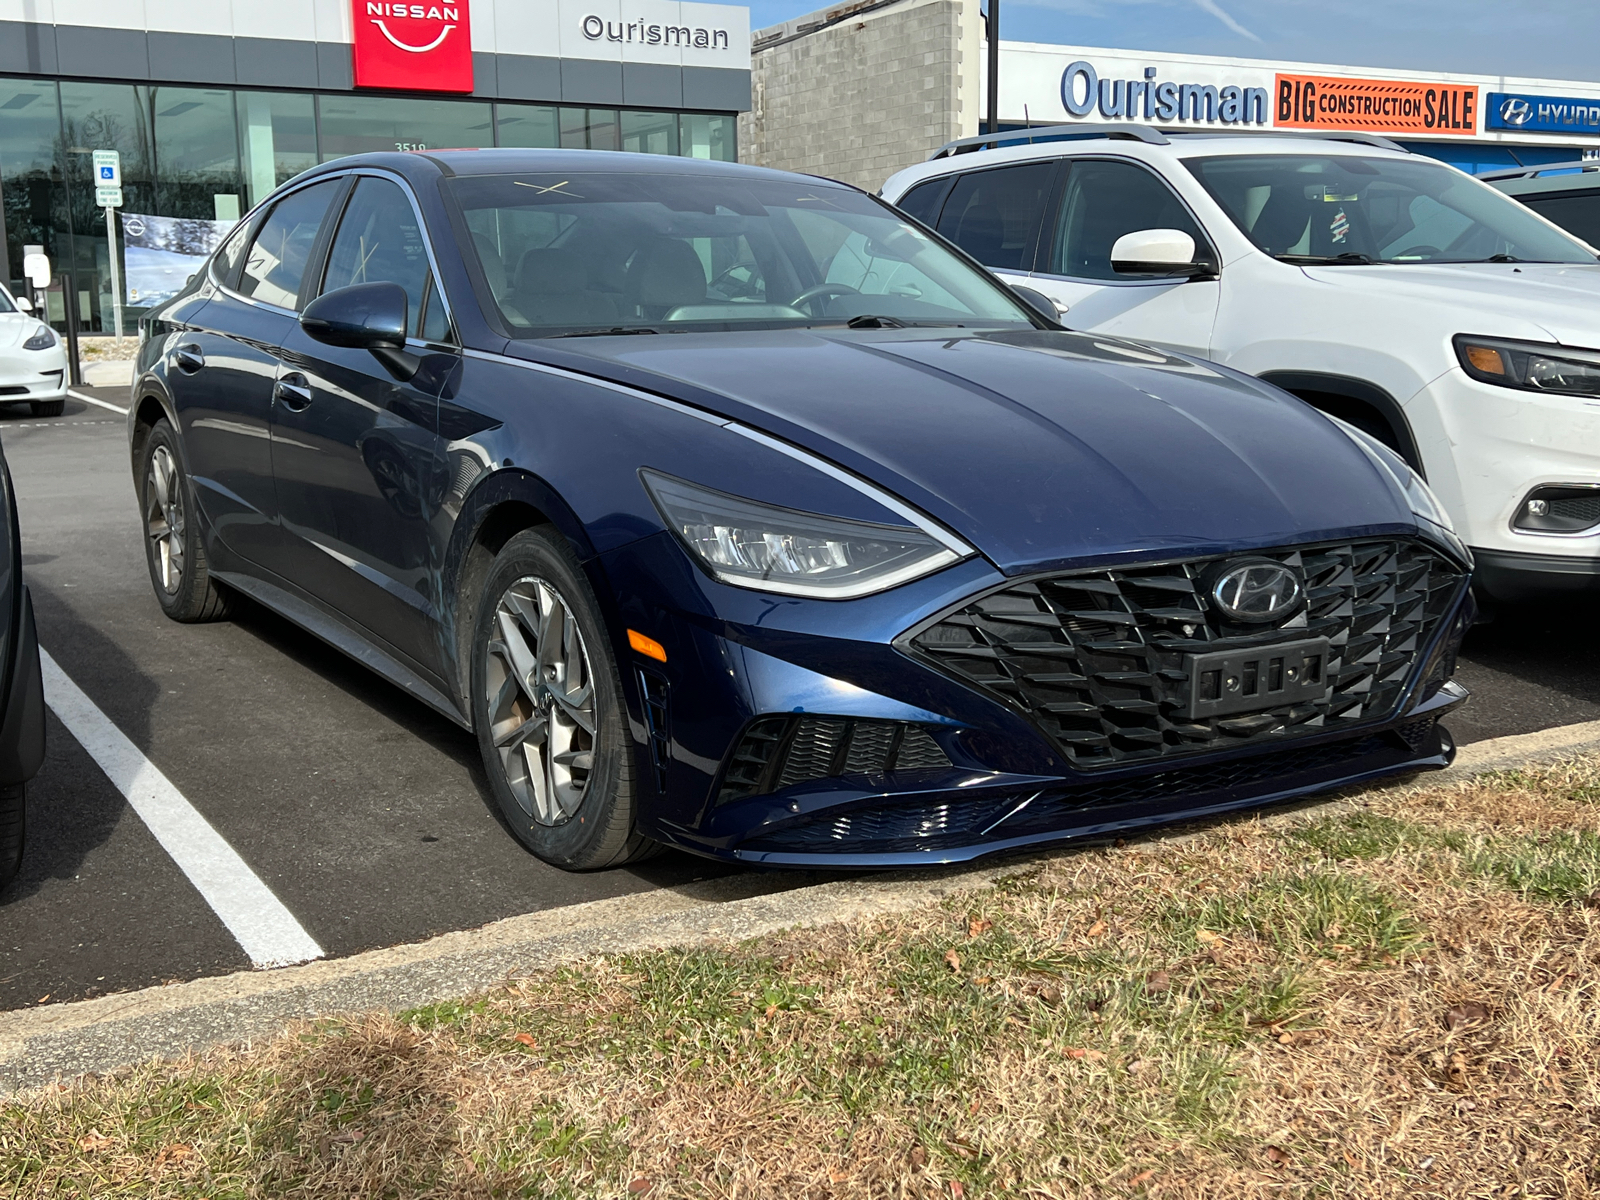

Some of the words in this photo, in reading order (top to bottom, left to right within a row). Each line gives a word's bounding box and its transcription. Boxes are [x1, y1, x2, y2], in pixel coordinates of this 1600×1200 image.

[366, 2, 459, 21] NISSAN
[582, 14, 729, 50] Ourisman
[1060, 60, 1269, 124] Ourisman
[1278, 80, 1316, 122] BIG
[1319, 94, 1422, 117] CONSTRUCTION
[1424, 89, 1475, 129] SALE
